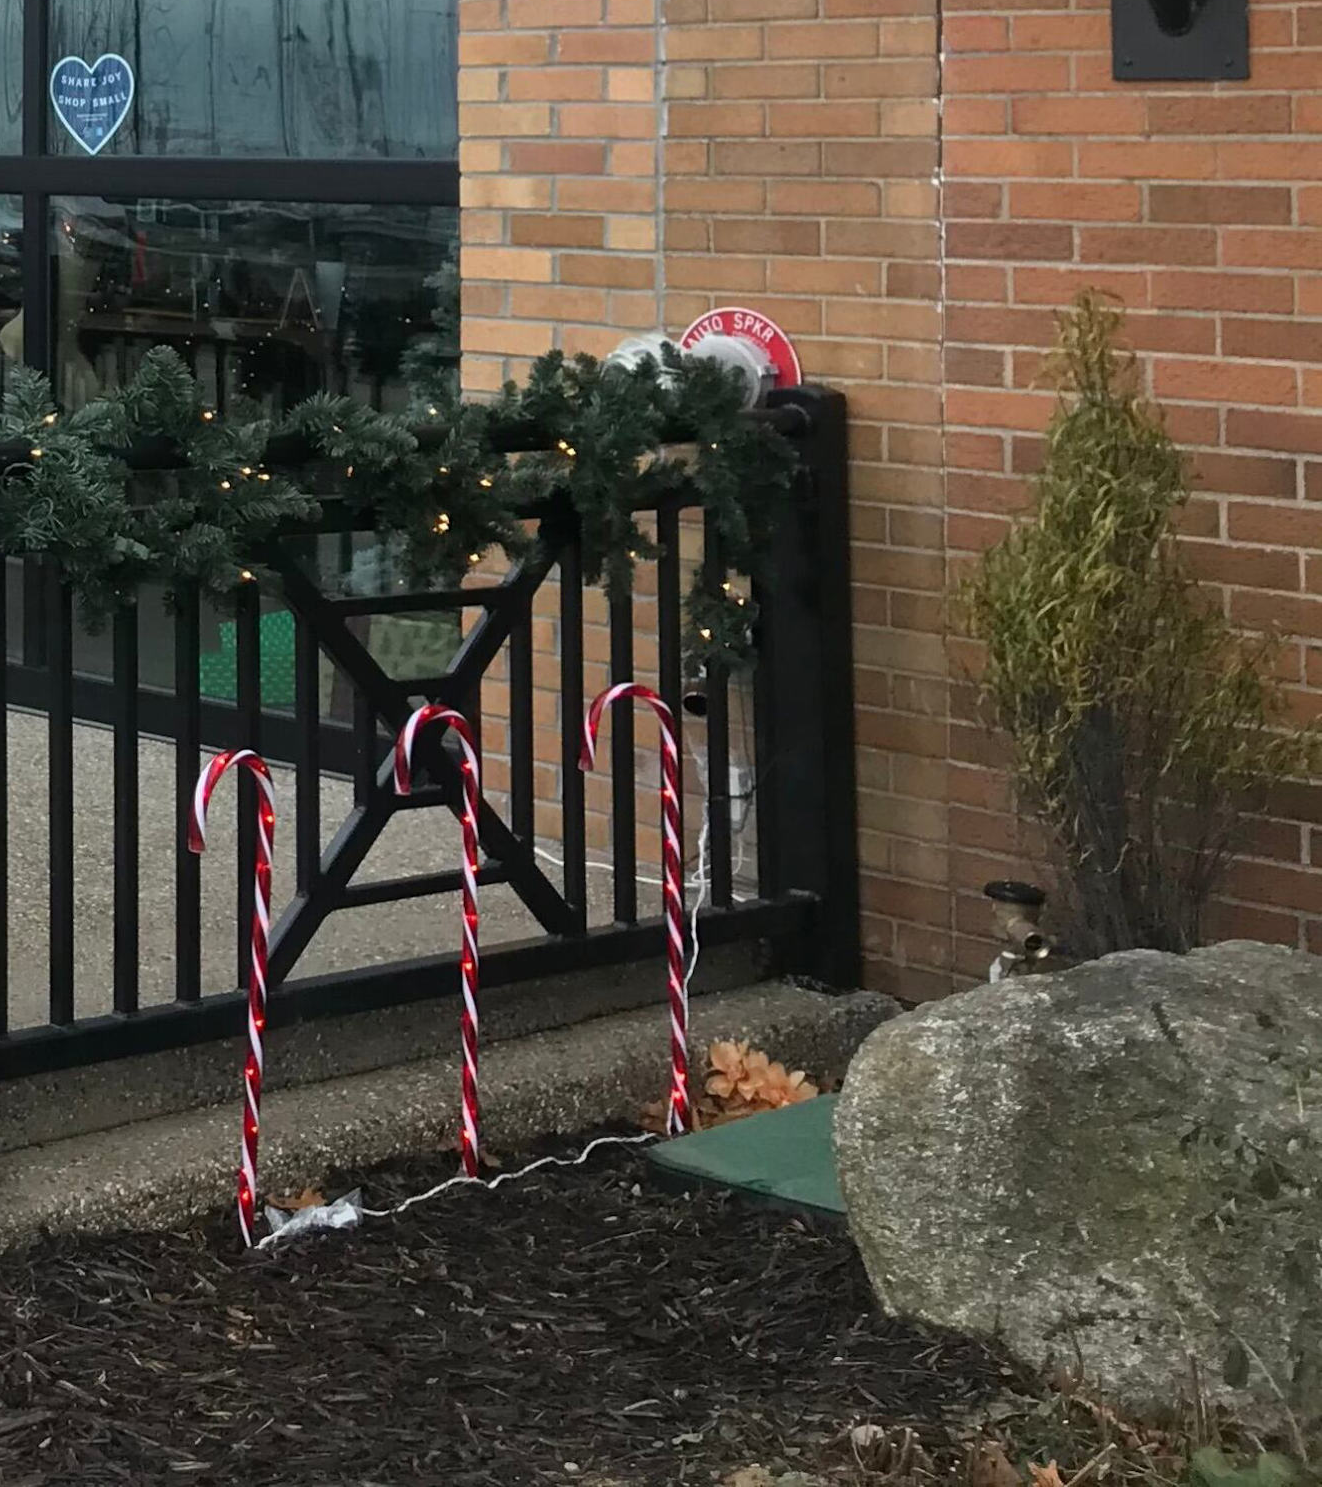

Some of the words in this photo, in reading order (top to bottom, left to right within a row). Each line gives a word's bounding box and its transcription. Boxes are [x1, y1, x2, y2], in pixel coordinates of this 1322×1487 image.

[61, 75, 96, 87] SHARE
[102, 72, 121, 85] JOY
[58, 95, 86, 107] SHOP
[93, 92, 127, 108] SMALL
[734, 313, 775, 343] SPKR
